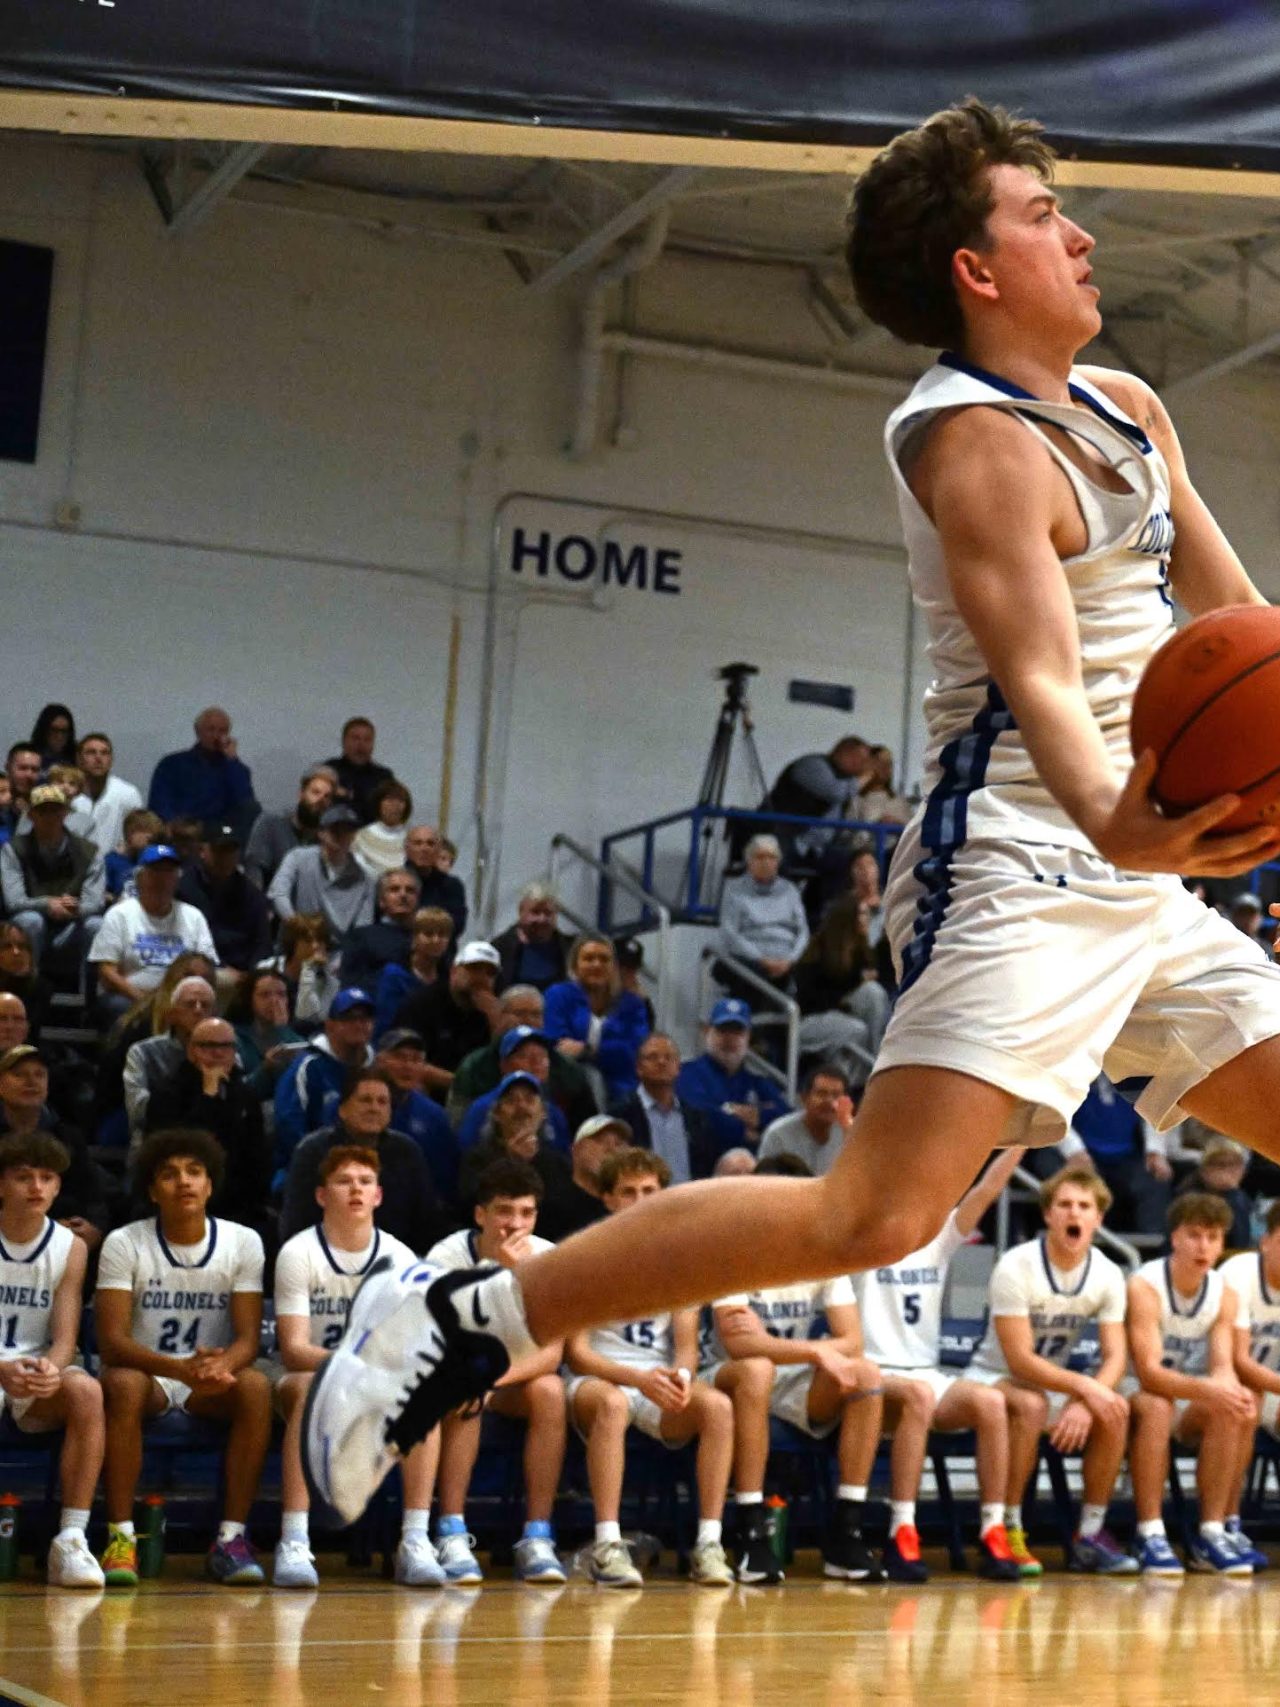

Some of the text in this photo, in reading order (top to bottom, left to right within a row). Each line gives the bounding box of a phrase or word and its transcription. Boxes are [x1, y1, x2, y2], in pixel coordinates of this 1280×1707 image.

[511, 527, 683, 594] HOME
[0, 1285, 50, 1308] NELS
[141, 1291, 229, 1311] COLONELS
[903, 1294, 921, 1325] 5
[159, 1316, 201, 1352] 24
